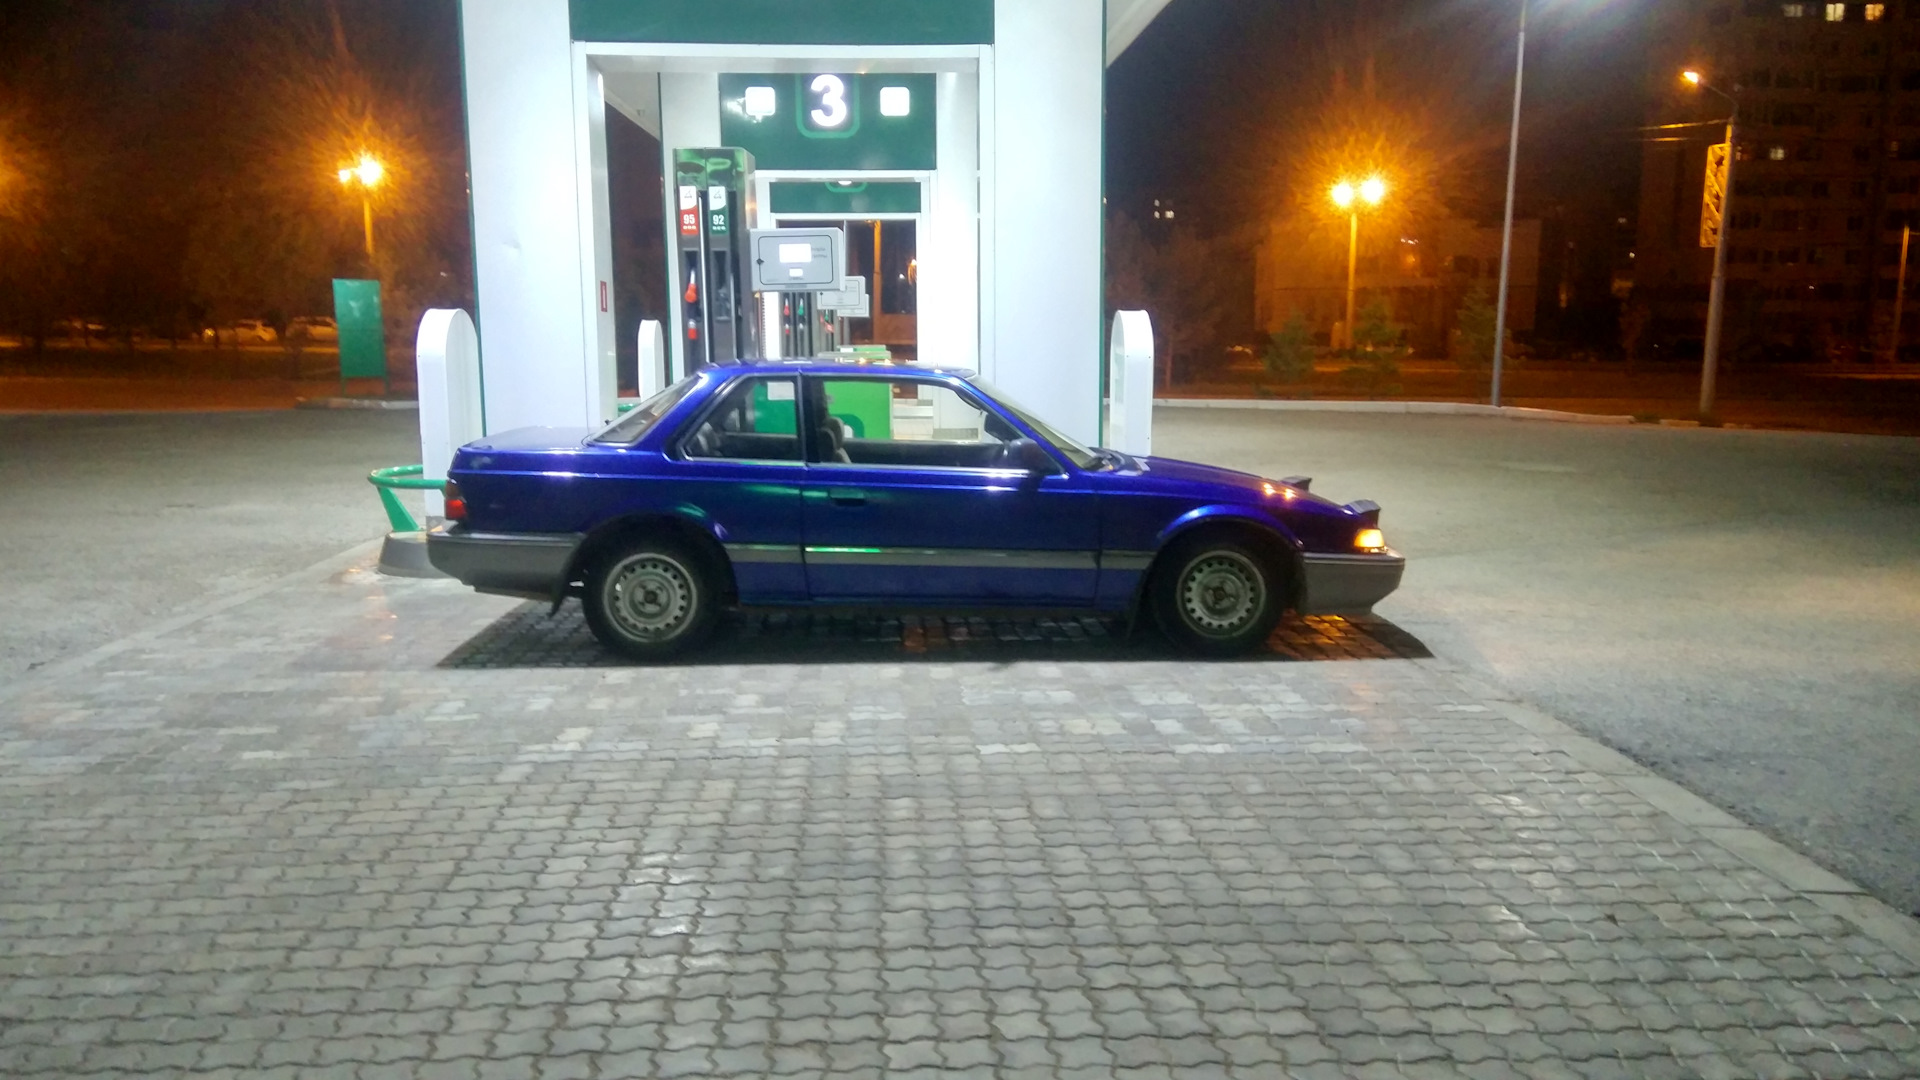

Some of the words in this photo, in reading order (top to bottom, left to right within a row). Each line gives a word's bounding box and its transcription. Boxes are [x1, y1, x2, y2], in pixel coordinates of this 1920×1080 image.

[810, 73, 847, 127] 3
[683, 214, 696, 225] 95
[712, 214, 725, 225] 92
